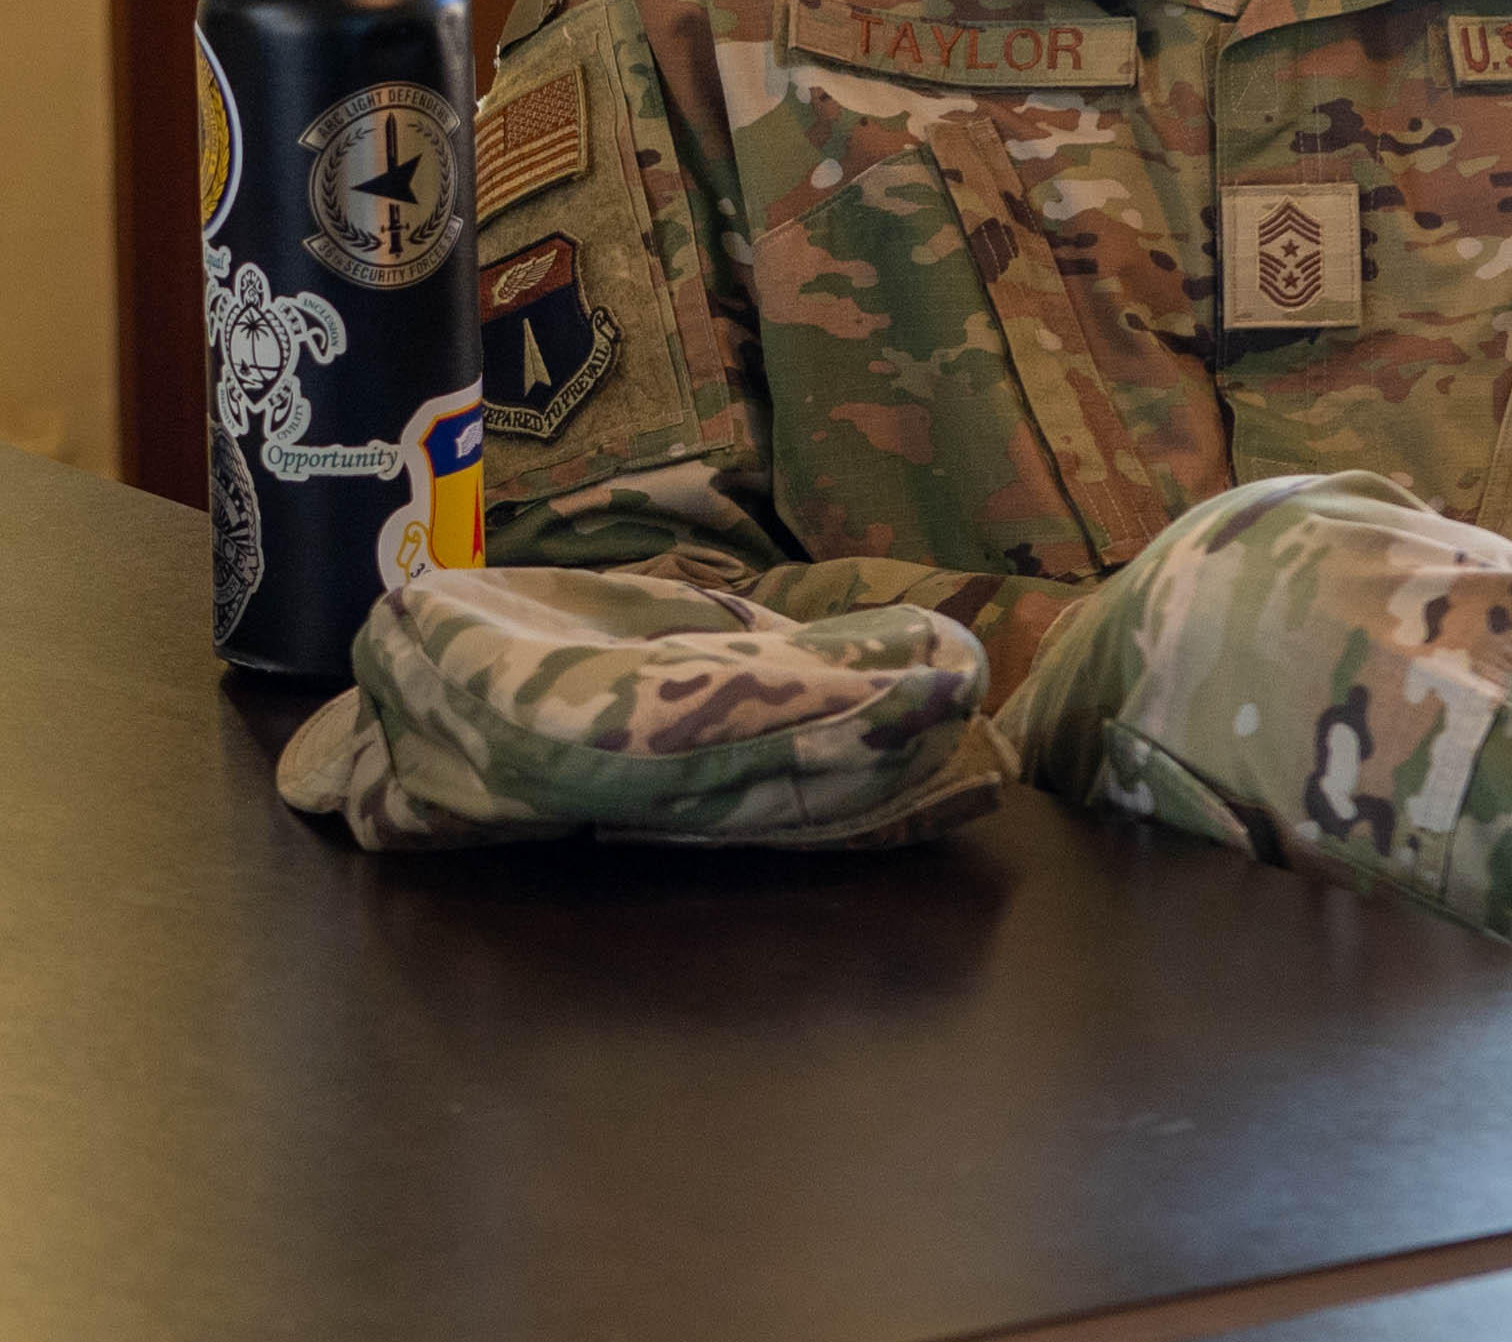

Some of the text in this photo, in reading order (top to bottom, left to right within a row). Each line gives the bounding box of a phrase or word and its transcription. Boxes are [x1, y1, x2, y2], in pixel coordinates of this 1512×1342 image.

[850, 12, 1084, 74] TAYLOR
[346, 92, 383, 117] LIGHT
[388, 89, 451, 123] DEFENDERS
[343, 261, 406, 282] SECURITY
[410, 243, 447, 276] FORCES
[561, 345, 610, 407] PREVAIL
[268, 445, 399, 474] Opportunity
